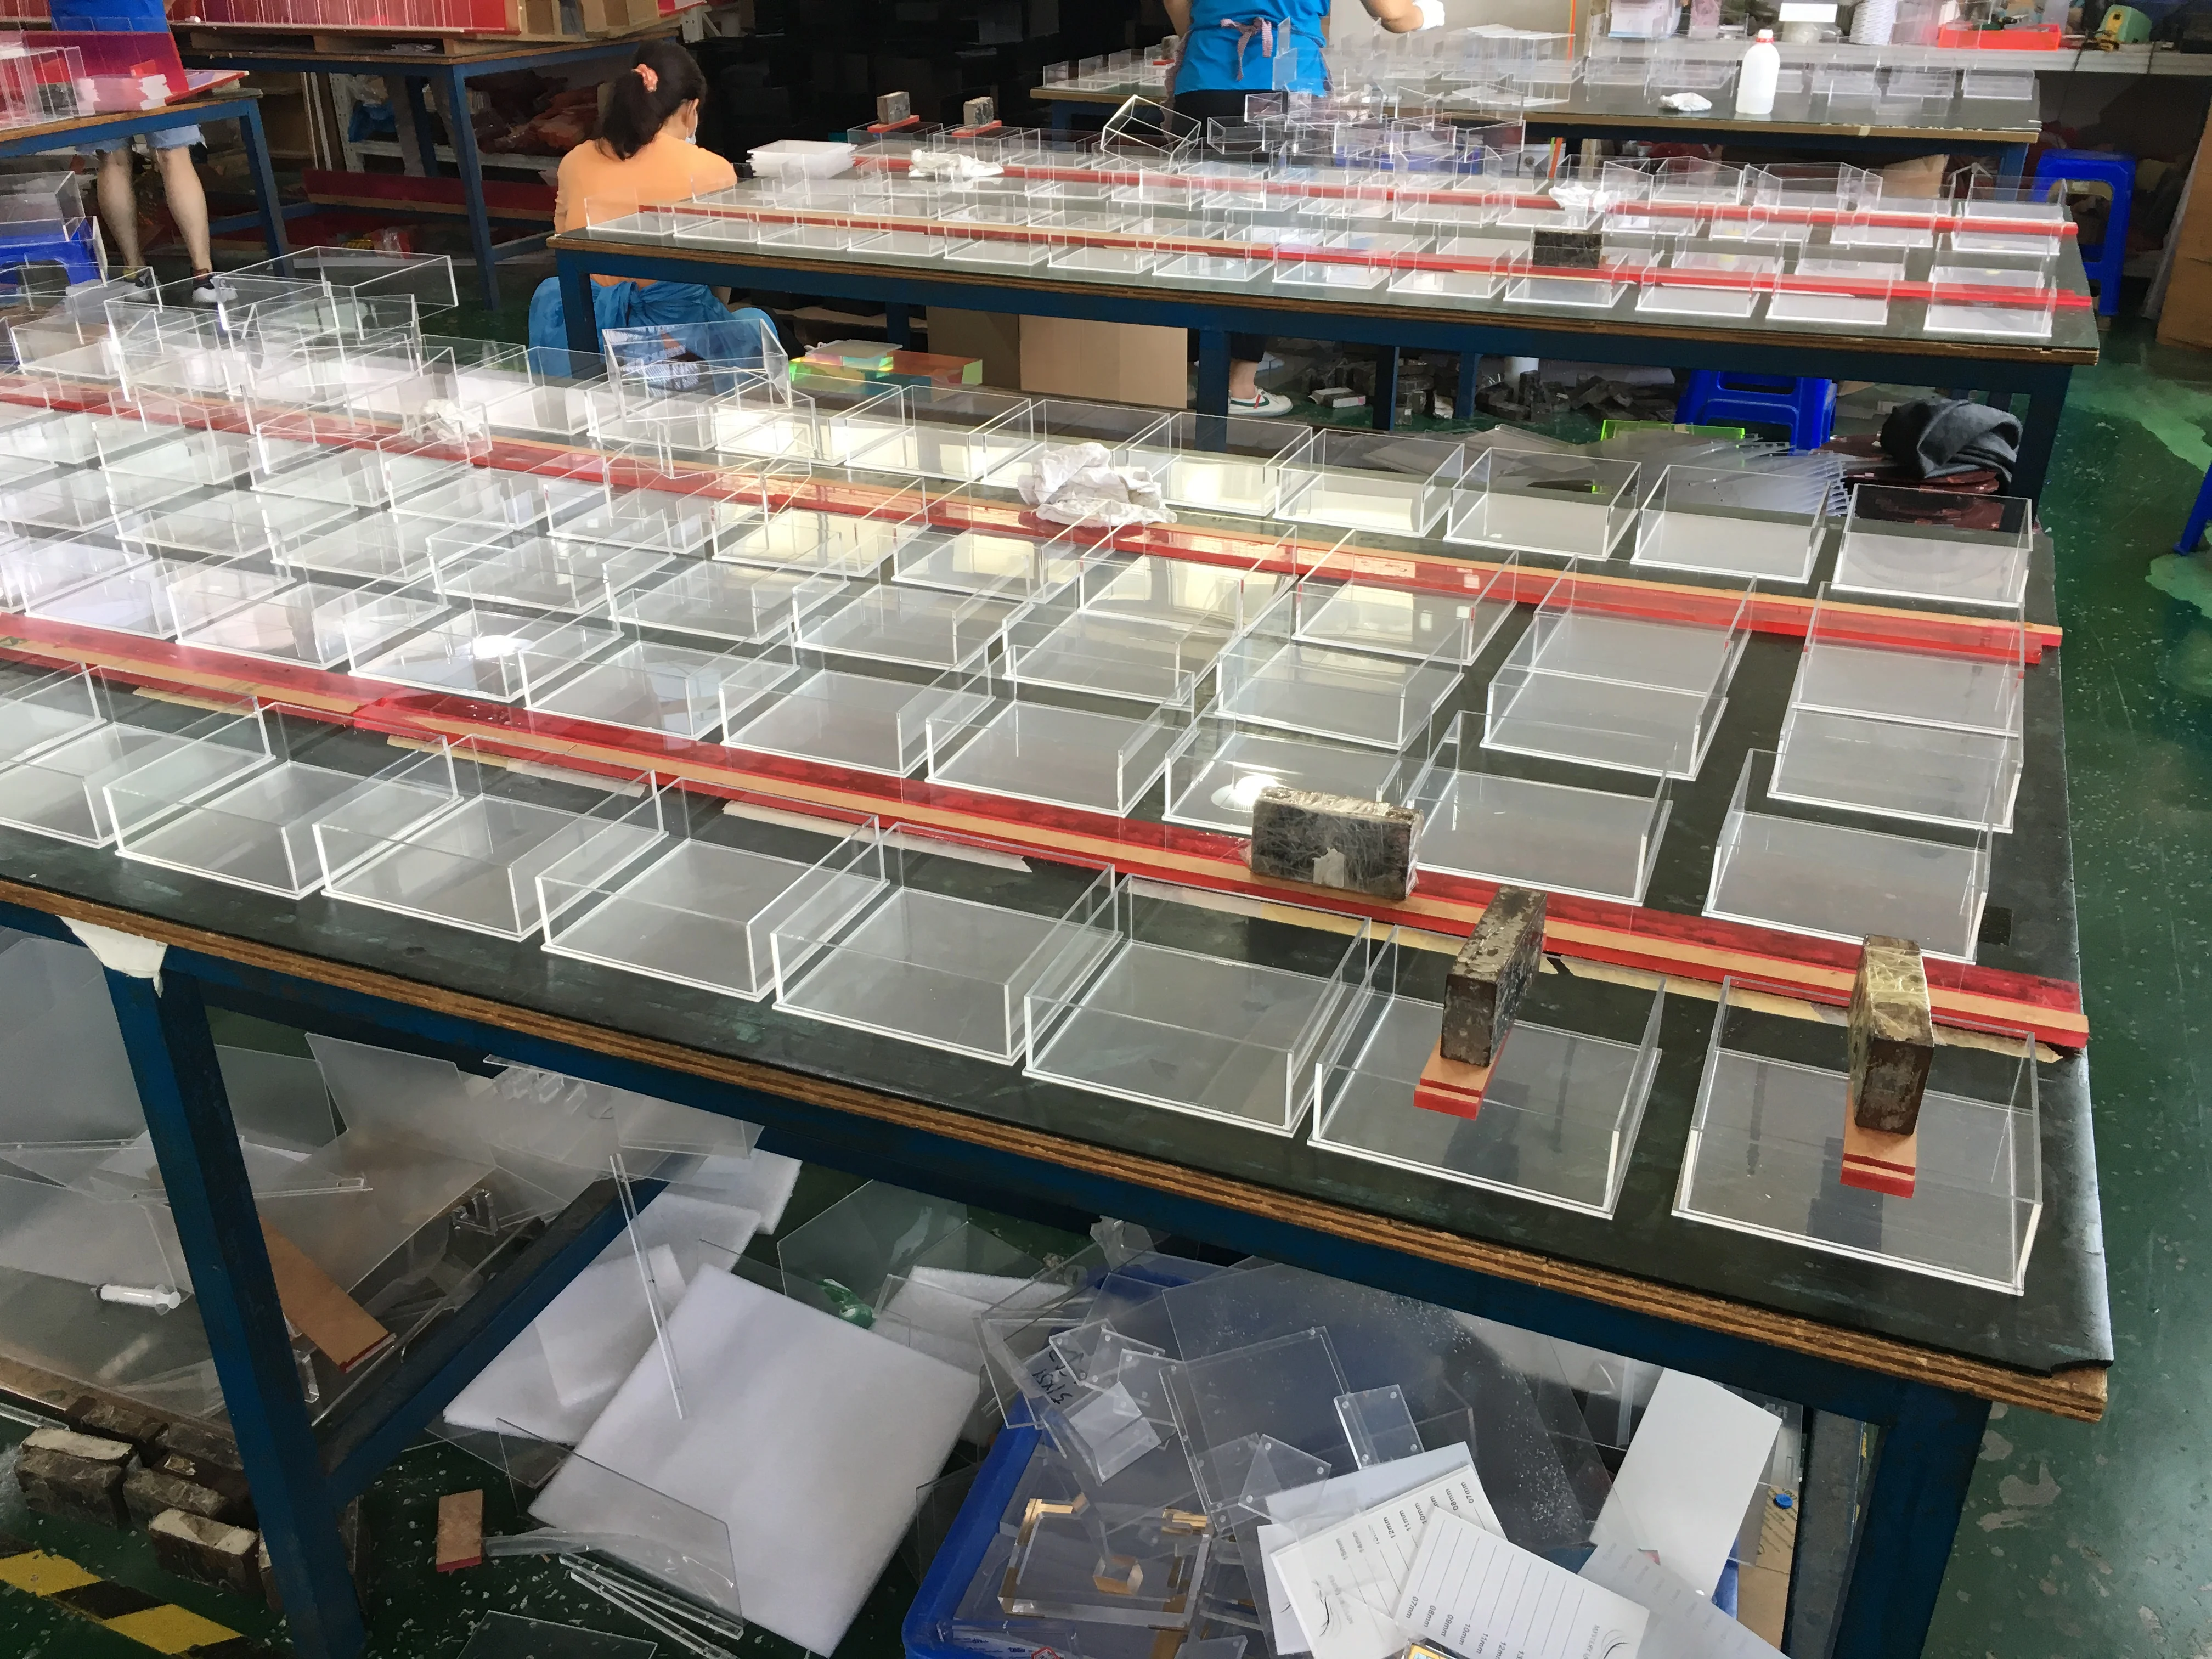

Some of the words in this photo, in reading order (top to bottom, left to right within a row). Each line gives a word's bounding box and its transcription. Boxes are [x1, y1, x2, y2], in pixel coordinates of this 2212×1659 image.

[1445, 1488, 1459, 1510] 08mm
[1461, 1481, 1474, 1503] 07mm
[1399, 1510, 1412, 1531] 11mm
[1414, 1502, 1427, 1524] 10mm
[1383, 1516, 1396, 1538] 12mm
[1406, 1596, 1419, 1619] 07mm
[1423, 1605, 1436, 1628] 08mm
[1441, 1613, 1454, 1637] 09mm
[1458, 1623, 1471, 1645] 10mm
[1476, 1633, 1489, 1654] 11mm
[1495, 1641, 1507, 1659] 12m
